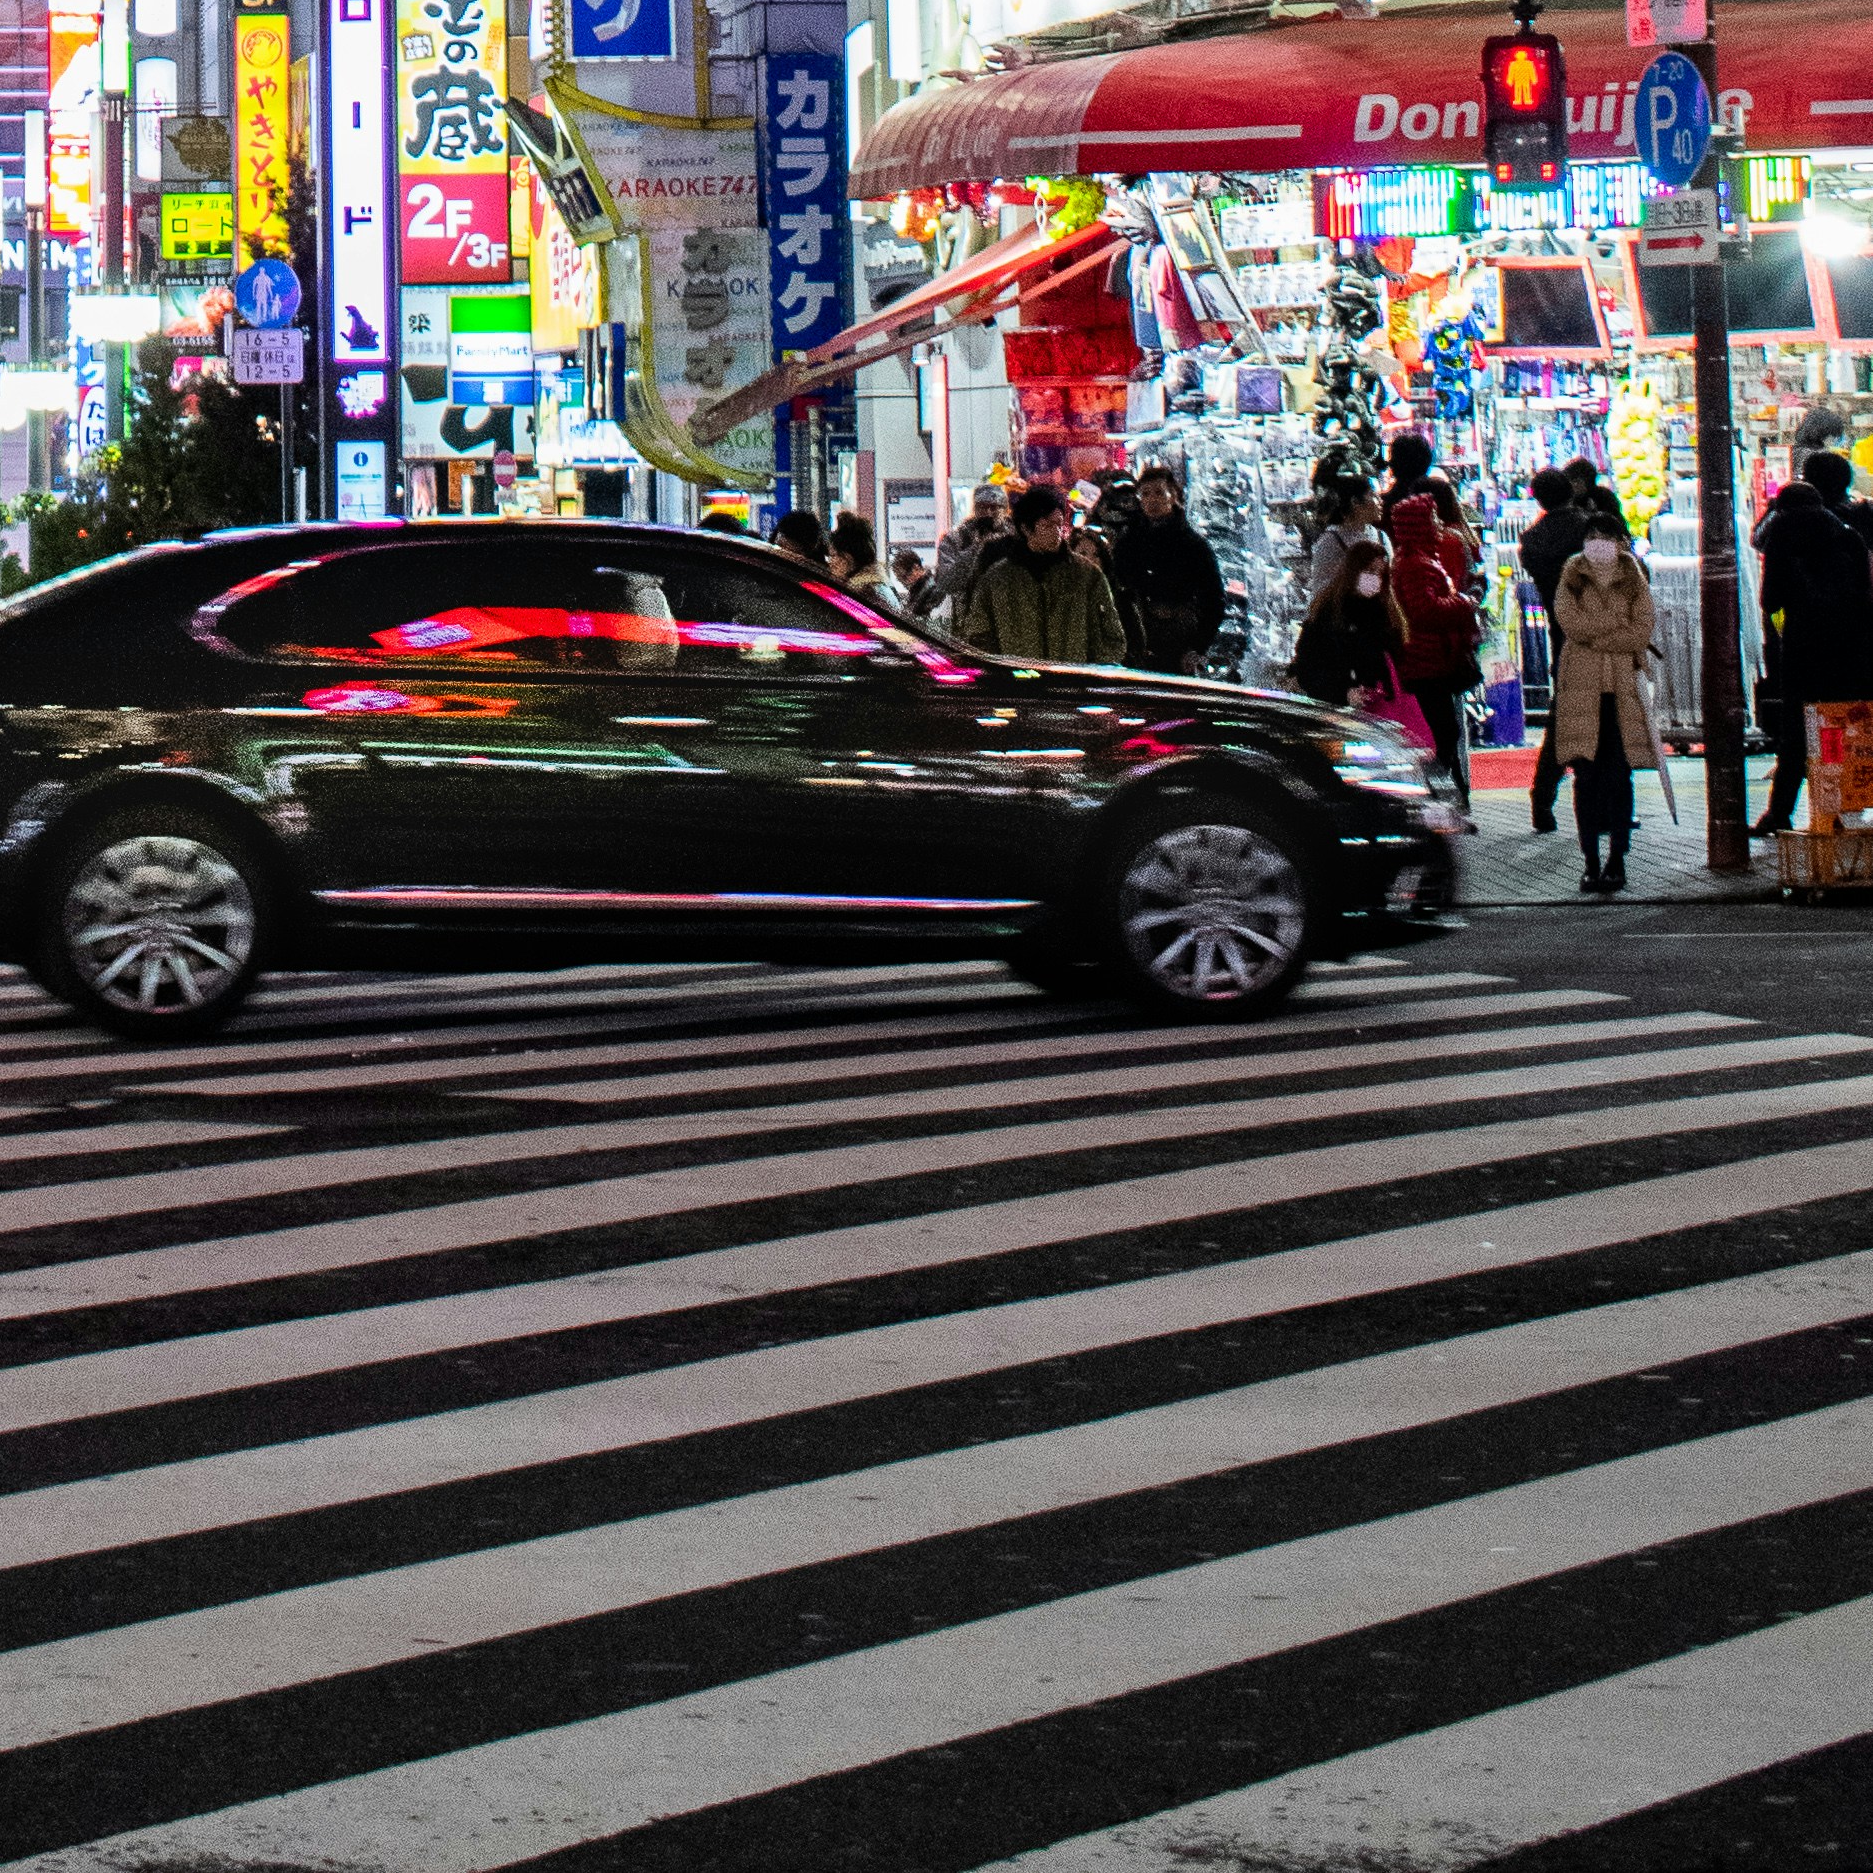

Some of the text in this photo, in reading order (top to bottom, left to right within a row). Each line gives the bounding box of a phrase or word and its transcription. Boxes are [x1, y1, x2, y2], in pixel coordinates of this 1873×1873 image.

[1353, 92, 1479, 143] Don
[1649, 85, 1679, 167] P
[406, 184, 473, 240] 2F
[776, 67, 836, 336] カラオケ
